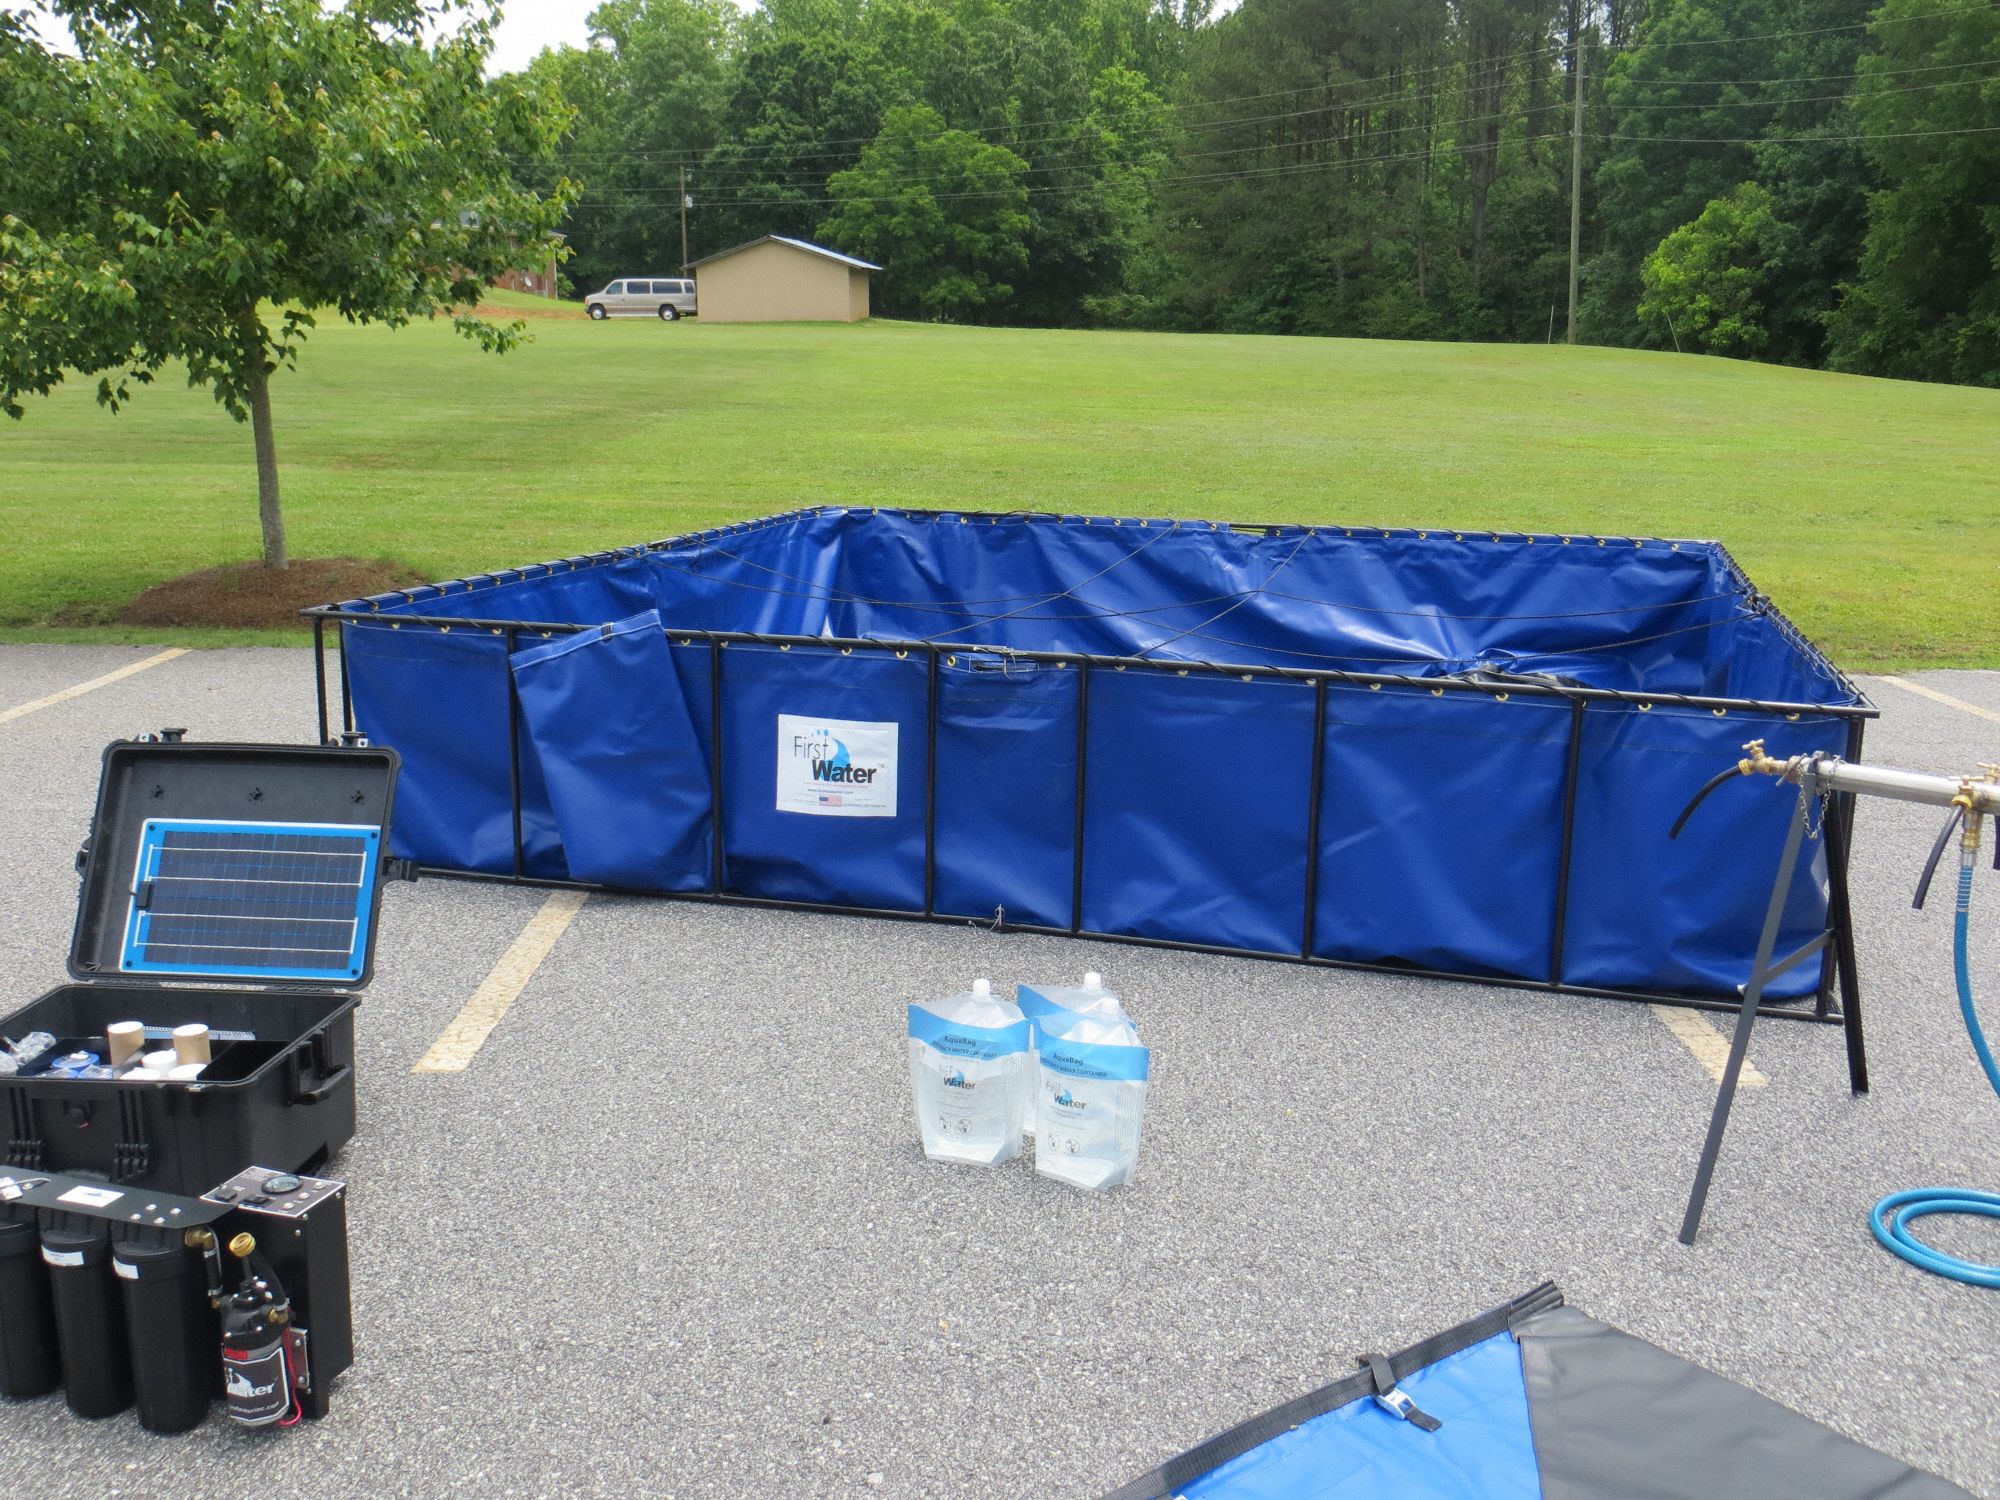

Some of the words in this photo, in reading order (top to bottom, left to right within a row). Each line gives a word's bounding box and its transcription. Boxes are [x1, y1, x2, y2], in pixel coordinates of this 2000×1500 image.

[794, 735, 829, 760] First
[811, 758, 877, 784] Water
[944, 1035, 977, 1047] AquaBag
[1053, 1052, 1084, 1067] AquaBag
[1076, 1069, 1107, 1078] CONTAINER
[943, 1077, 977, 1090] Water
[1053, 1093, 1087, 1110] Water
